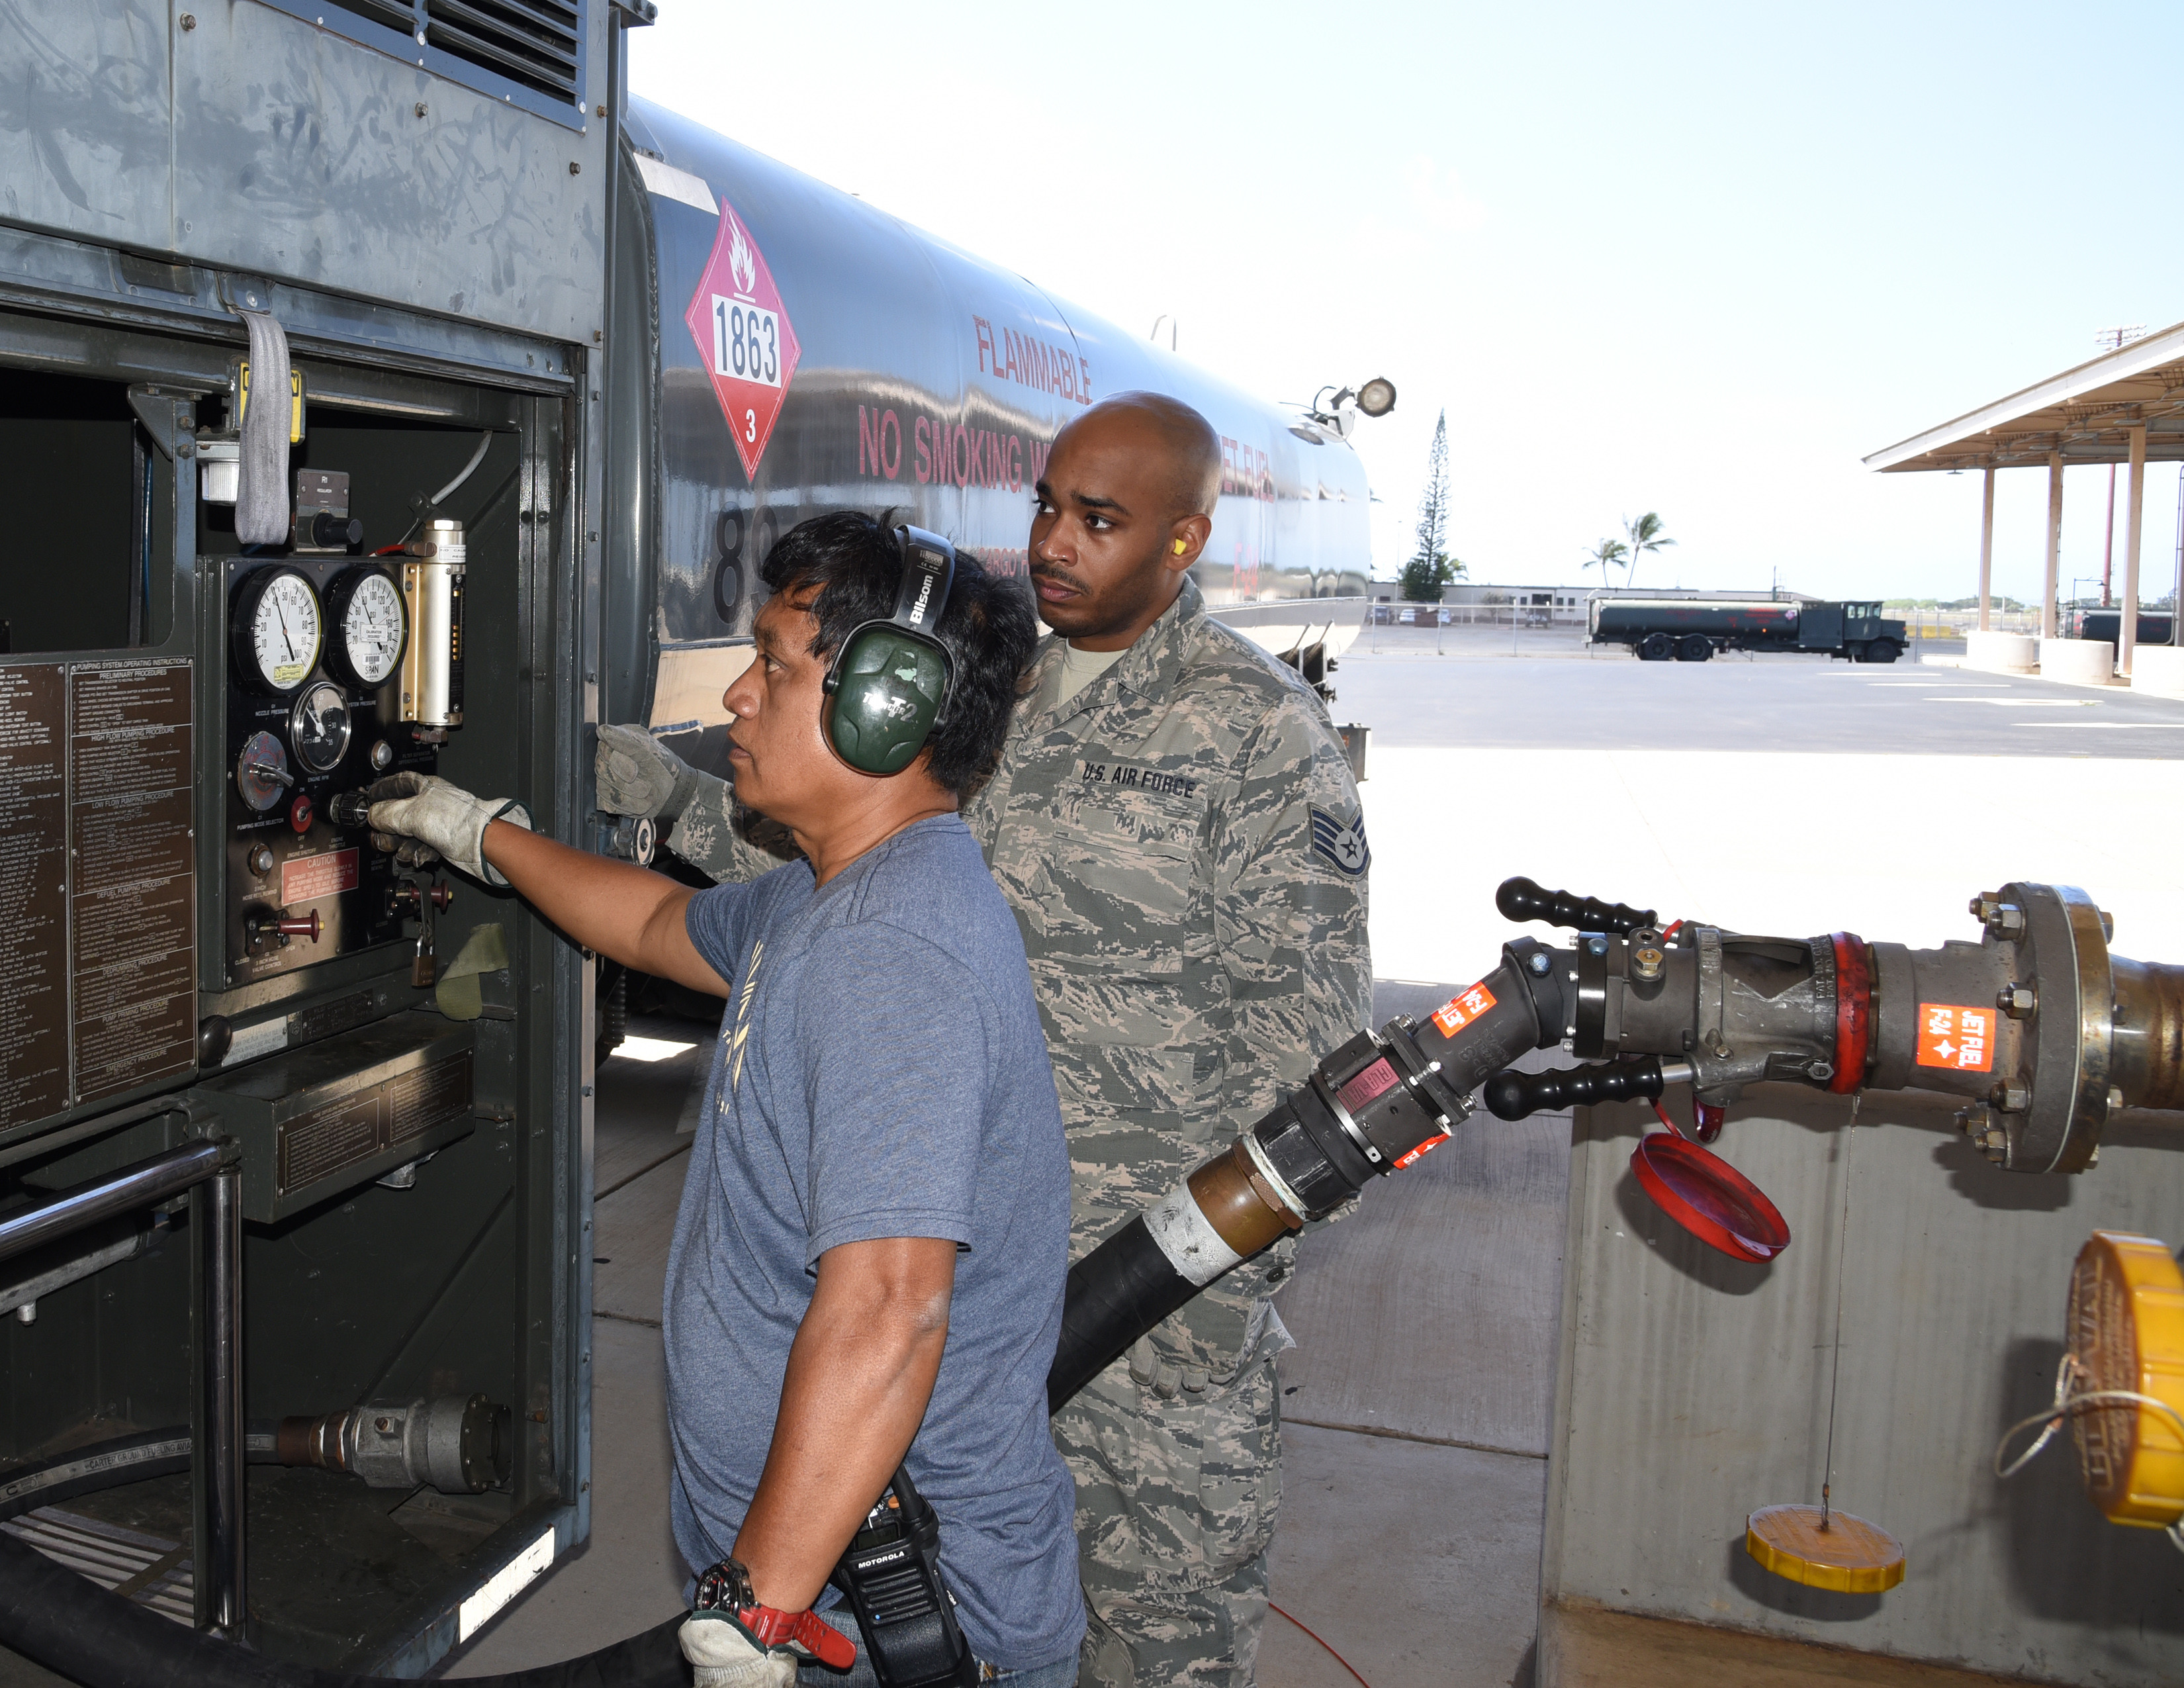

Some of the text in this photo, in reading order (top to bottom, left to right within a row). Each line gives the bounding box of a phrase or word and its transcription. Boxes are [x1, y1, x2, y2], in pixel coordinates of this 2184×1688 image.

[717, 301, 776, 383] 1863
[972, 314, 1093, 405] FLAMMABLE
[746, 408, 756, 443] 3
[859, 405, 901, 480] NO
[915, 416, 1022, 493] SMOKING
[1244, 444, 1274, 504] FUEL
[272, 597, 278, 606] 40
[282, 592, 288, 601] 50
[291, 596, 296, 605] 60
[362, 596, 367, 605] 80
[265, 608, 271, 617] 30
[298, 606, 304, 615] 70
[355, 606, 361, 616] 60
[261, 622, 267, 632] 20
[302, 620, 308, 630] 80
[351, 620, 357, 630] 40
[261, 639, 267, 648] 10
[301, 637, 306, 645] 90
[352, 635, 358, 645] 20
[77, 663, 101, 671] PUMPING
[152, 657, 187, 666] INSTRUCTIONS
[365, 665, 379, 675] SPAN
[122, 729, 144, 738] PUMPING
[145, 727, 175, 736] PROCEDURE
[1083, 763, 1195, 799] U.S. AIR FORCE
[120, 795, 144, 804] PUMPING
[145, 790, 174, 801] PROCEDURE
[307, 855, 336, 868] CAUTION
[118, 884, 141, 894] PUMPING
[142, 878, 171, 889] PROCEDURE
[138, 955, 168, 966] PROCEDURE
[118, 1008, 139, 1018] PRIMING
[140, 999, 169, 1011] PROCEDURE
[1929, 1008, 1952, 1035] F-24
[1958, 1011, 1985, 1066] JET FUEL
[106, 1049, 167, 1072] EMERGENCY PROCEDURE
[1347, 1064, 1393, 1104] CLA-VA
[89, 1456, 116, 1470] CARTER
[118, 1450, 146, 1462] GROUND
[148, 1444, 175, 1457] FUELING
[858, 1550, 905, 1569] MOTOROLA
